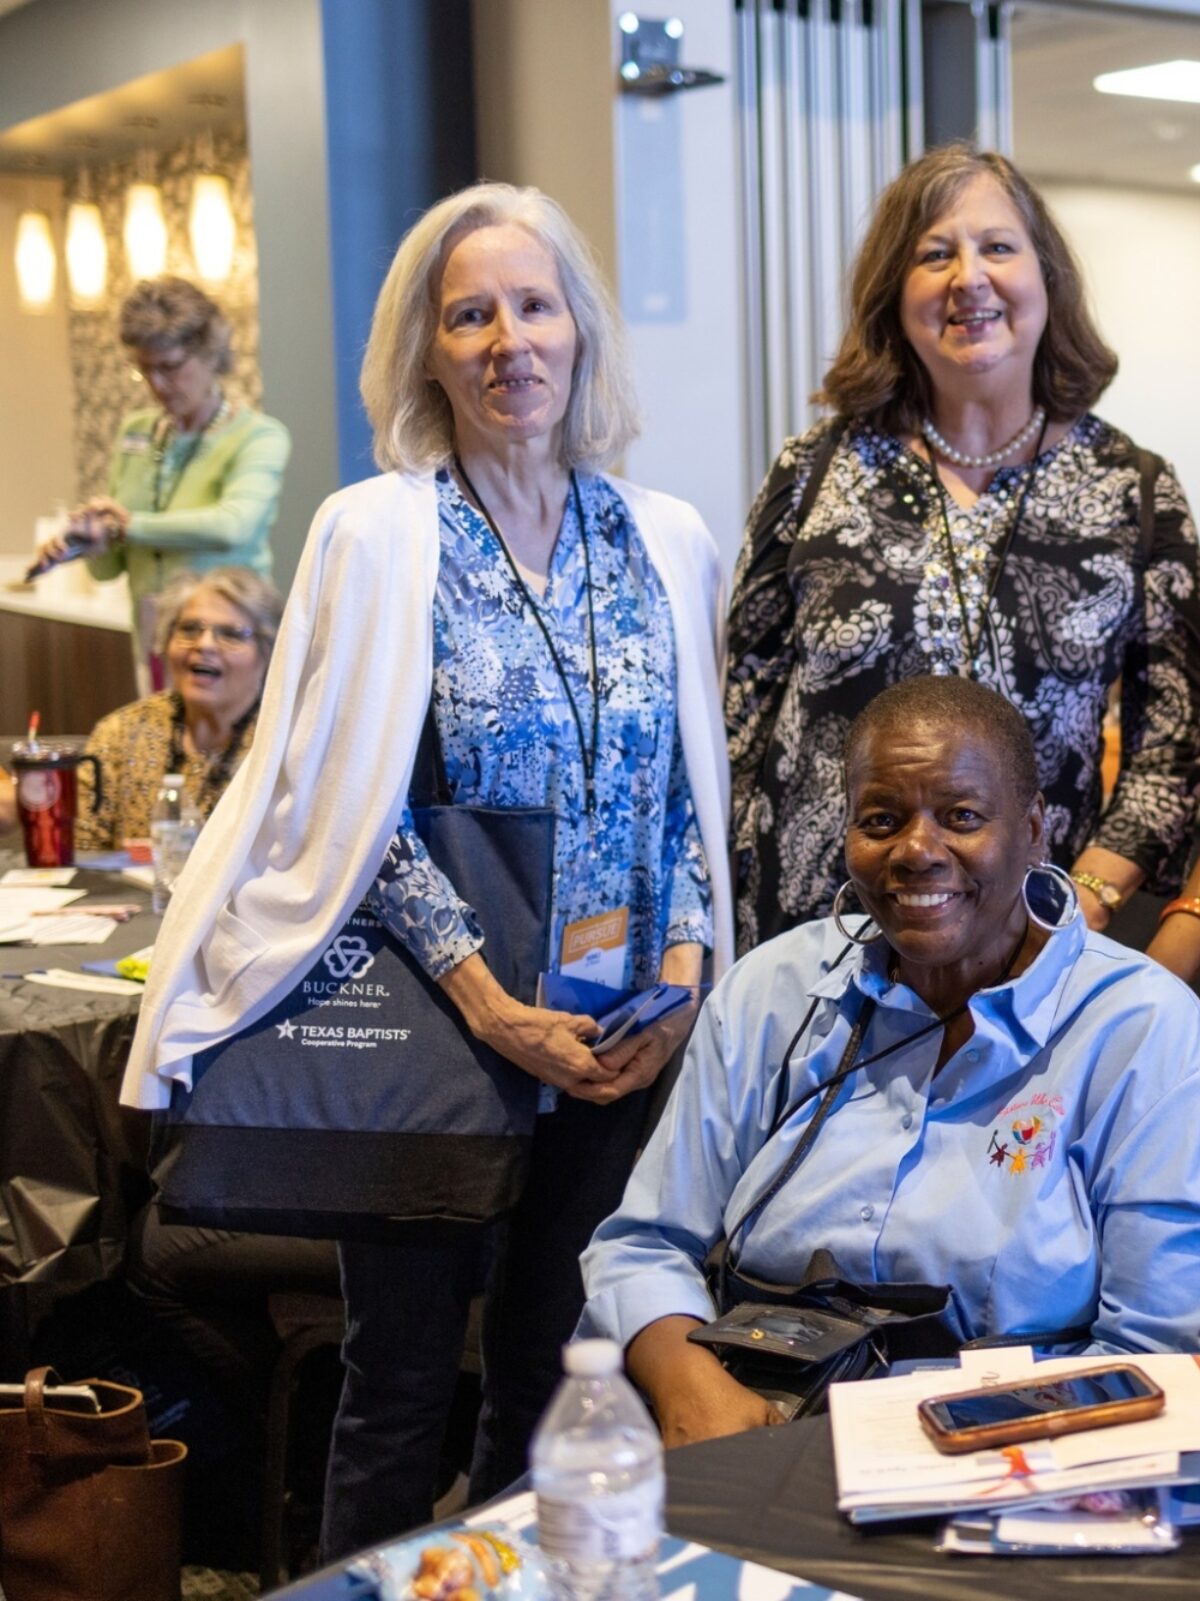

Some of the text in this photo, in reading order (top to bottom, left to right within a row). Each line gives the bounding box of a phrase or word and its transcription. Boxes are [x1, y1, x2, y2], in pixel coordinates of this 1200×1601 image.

[308, 996, 331, 1008] Hope
[333, 998, 358, 1008] shines
[301, 1025, 410, 1041] TEXAS BAPTISTS
[301, 1038, 378, 1049] Cooperative Program
